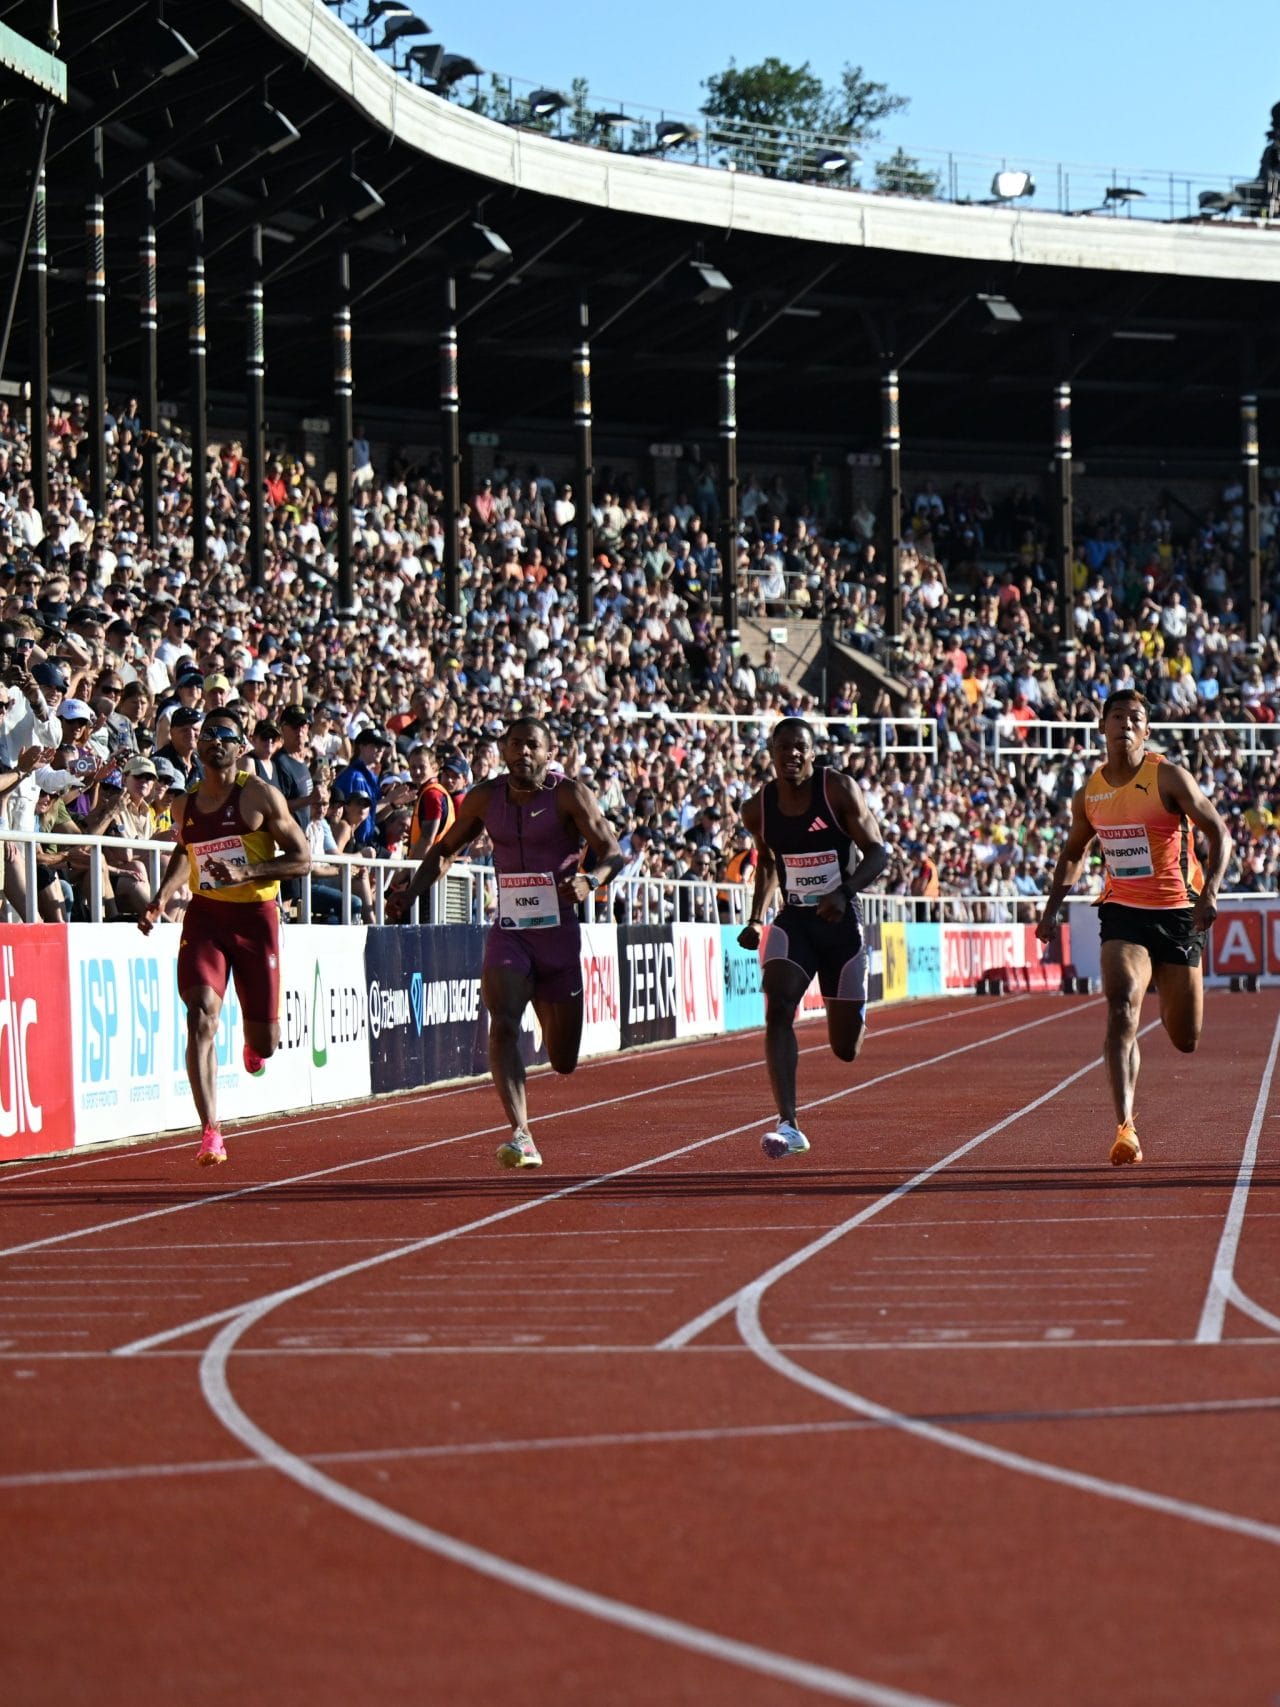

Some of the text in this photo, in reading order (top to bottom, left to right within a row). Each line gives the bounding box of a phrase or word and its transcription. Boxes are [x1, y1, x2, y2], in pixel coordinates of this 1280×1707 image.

[195, 840, 241, 856] BAUHAUS
[1116, 846, 1148, 857] BROWN
[784, 854, 835, 867] BAUHAUS
[501, 877, 552, 887] BAUHAUS
[795, 875, 828, 887] FORDE
[515, 896, 539, 906] KING
[626, 942, 677, 1024] ZEEKR
[449, 978, 482, 1023] LEAGUE
[80, 959, 118, 1083] ISP
[128, 957, 160, 1077] ISP
[330, 987, 367, 1043] ELEDA
